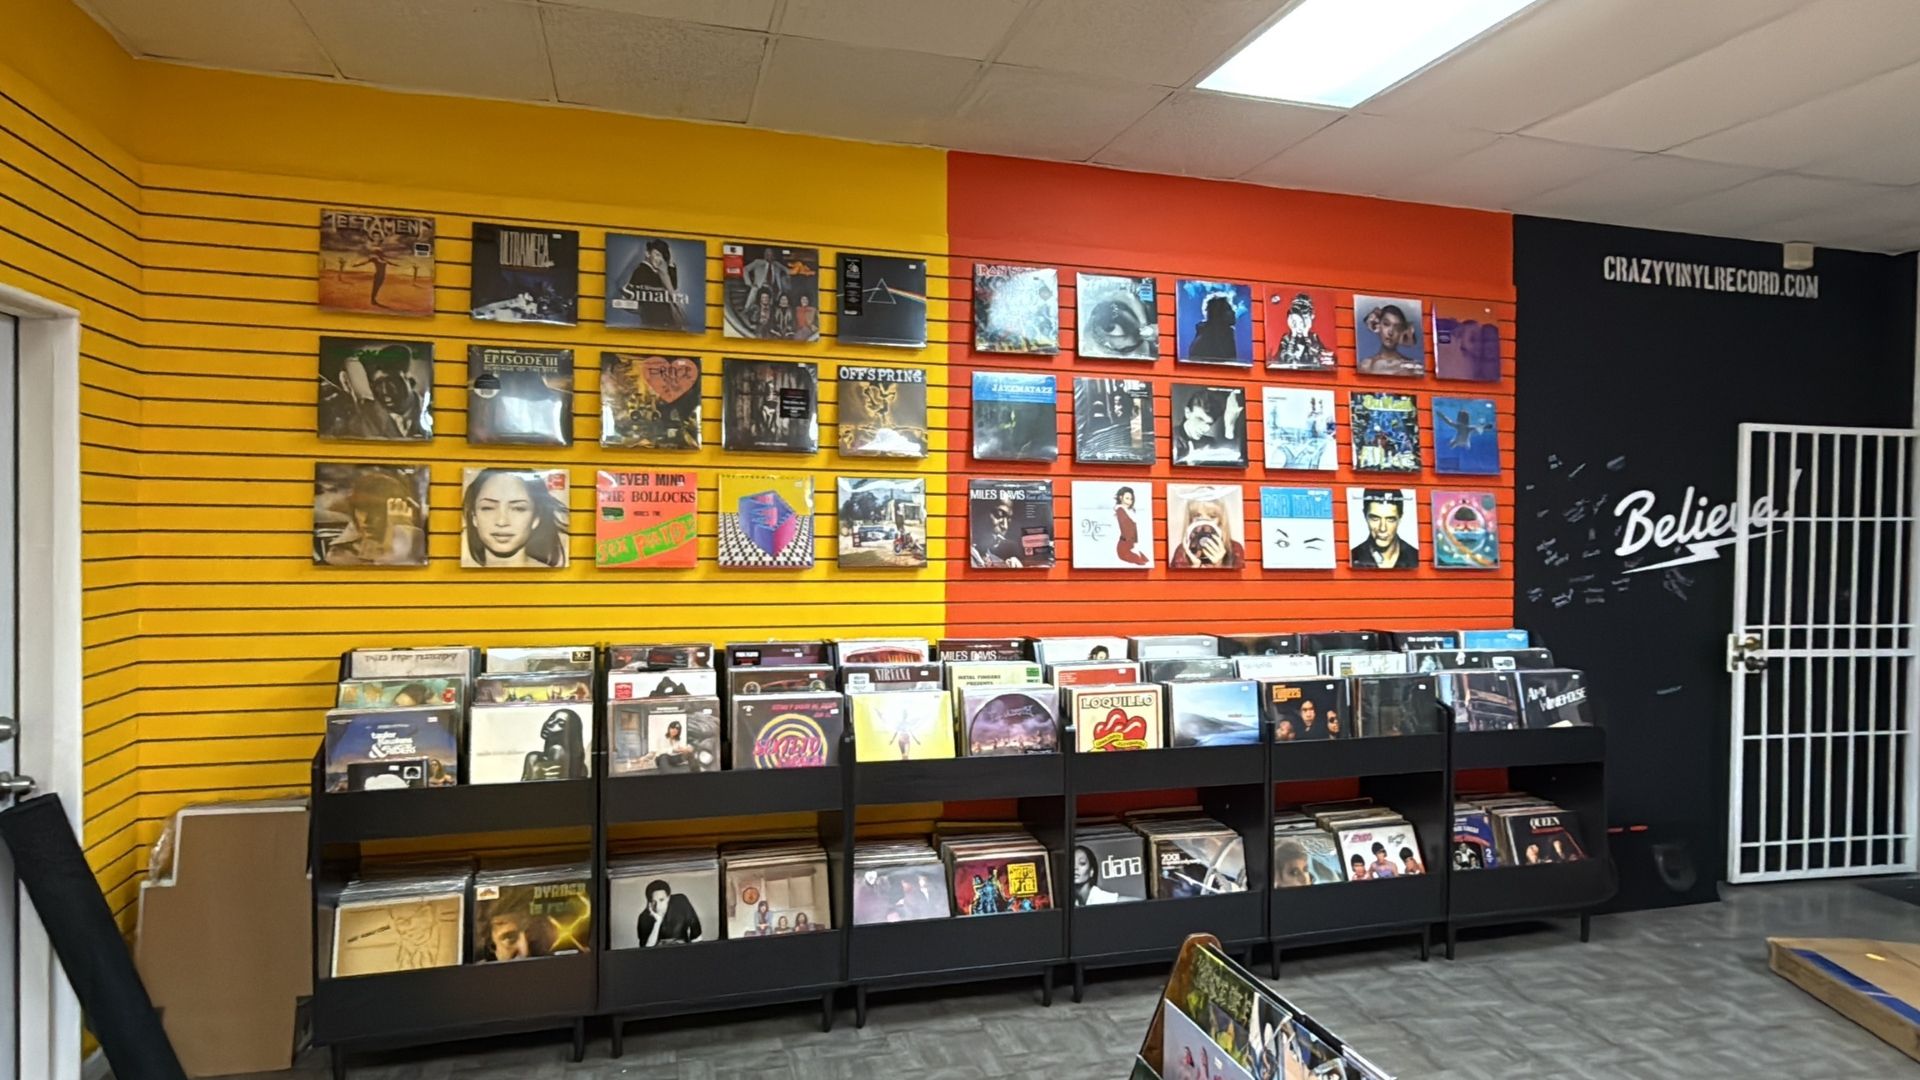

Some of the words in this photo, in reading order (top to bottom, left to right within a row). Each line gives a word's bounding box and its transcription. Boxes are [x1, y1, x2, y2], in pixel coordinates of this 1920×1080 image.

[1603, 255, 1818, 299] CRAZYVINYLRECORD.COM
[621, 284, 690, 306] Sinatra
[483, 353, 542, 366] EPISODE
[839, 366, 923, 383] OFFSPRING
[631, 491, 696, 504] BOLLOCKS
[970, 488, 998, 500] MILES
[1000, 489, 1026, 500] DAVIS
[940, 650, 968, 661] MILES
[970, 650, 997, 661] DAVIS
[875, 668, 911, 681] NIRVANA
[1081, 695, 1154, 710] LOQUILLO
[1529, 816, 1561, 830] QUEEN
[1101, 855, 1142, 879] diana
